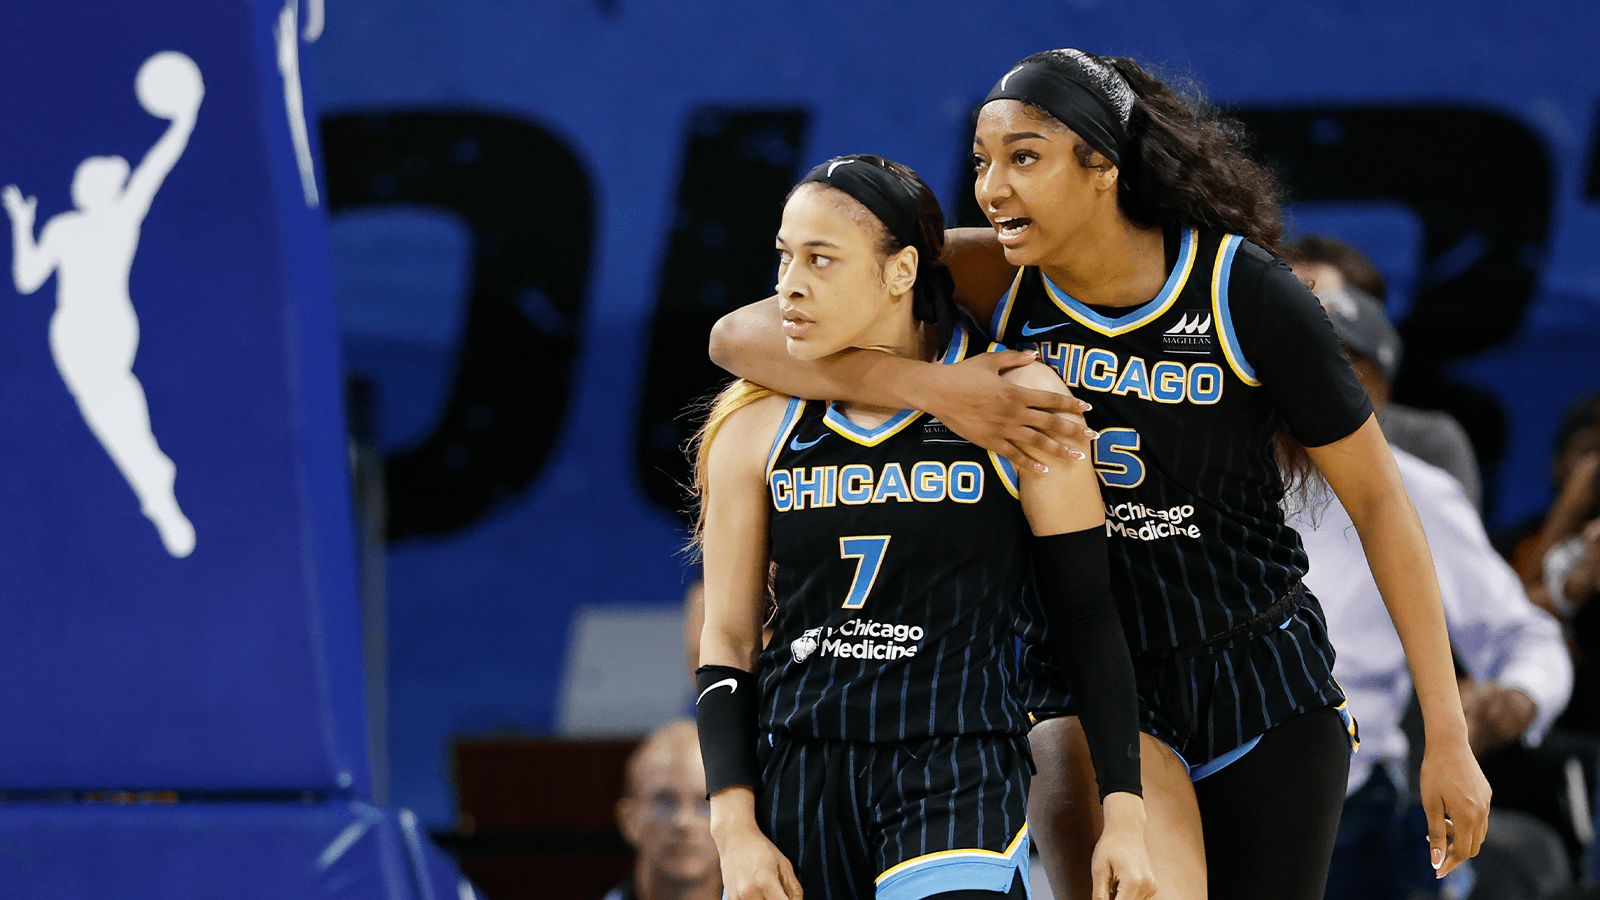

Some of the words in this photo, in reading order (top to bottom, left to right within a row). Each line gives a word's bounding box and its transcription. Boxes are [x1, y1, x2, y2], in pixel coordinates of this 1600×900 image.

[1162, 337, 1211, 345] MAGELLAN
[1017, 341, 1224, 405] HICAGO
[1093, 427, 1146, 489] 5
[769, 461, 985, 512] CHICAGO
[1105, 519, 1201, 541] Medicine
[839, 535, 892, 609] 7
[820, 638, 918, 660] Medicine
